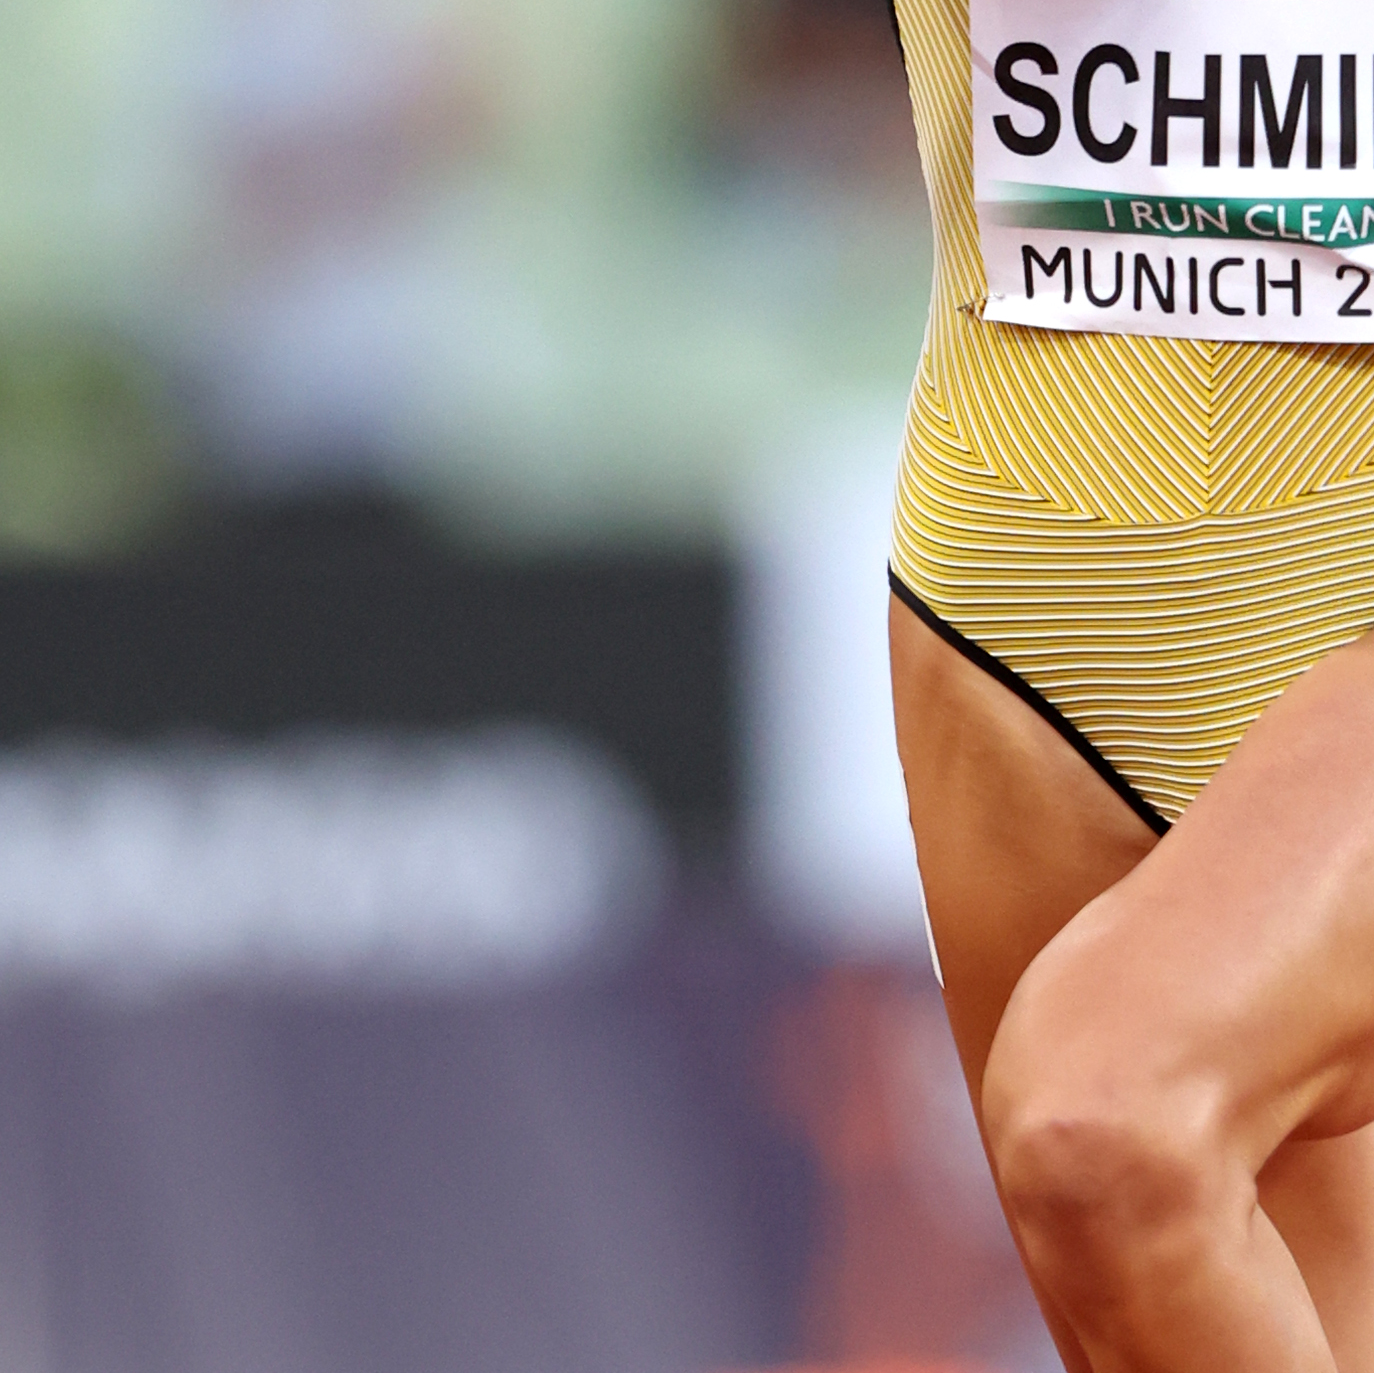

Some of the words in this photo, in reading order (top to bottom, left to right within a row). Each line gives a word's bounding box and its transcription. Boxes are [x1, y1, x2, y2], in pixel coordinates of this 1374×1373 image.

[1103, 199, 1116, 228] I
[1131, 201, 1229, 234] RUN
[1021, 245, 1302, 317] MUNICH
